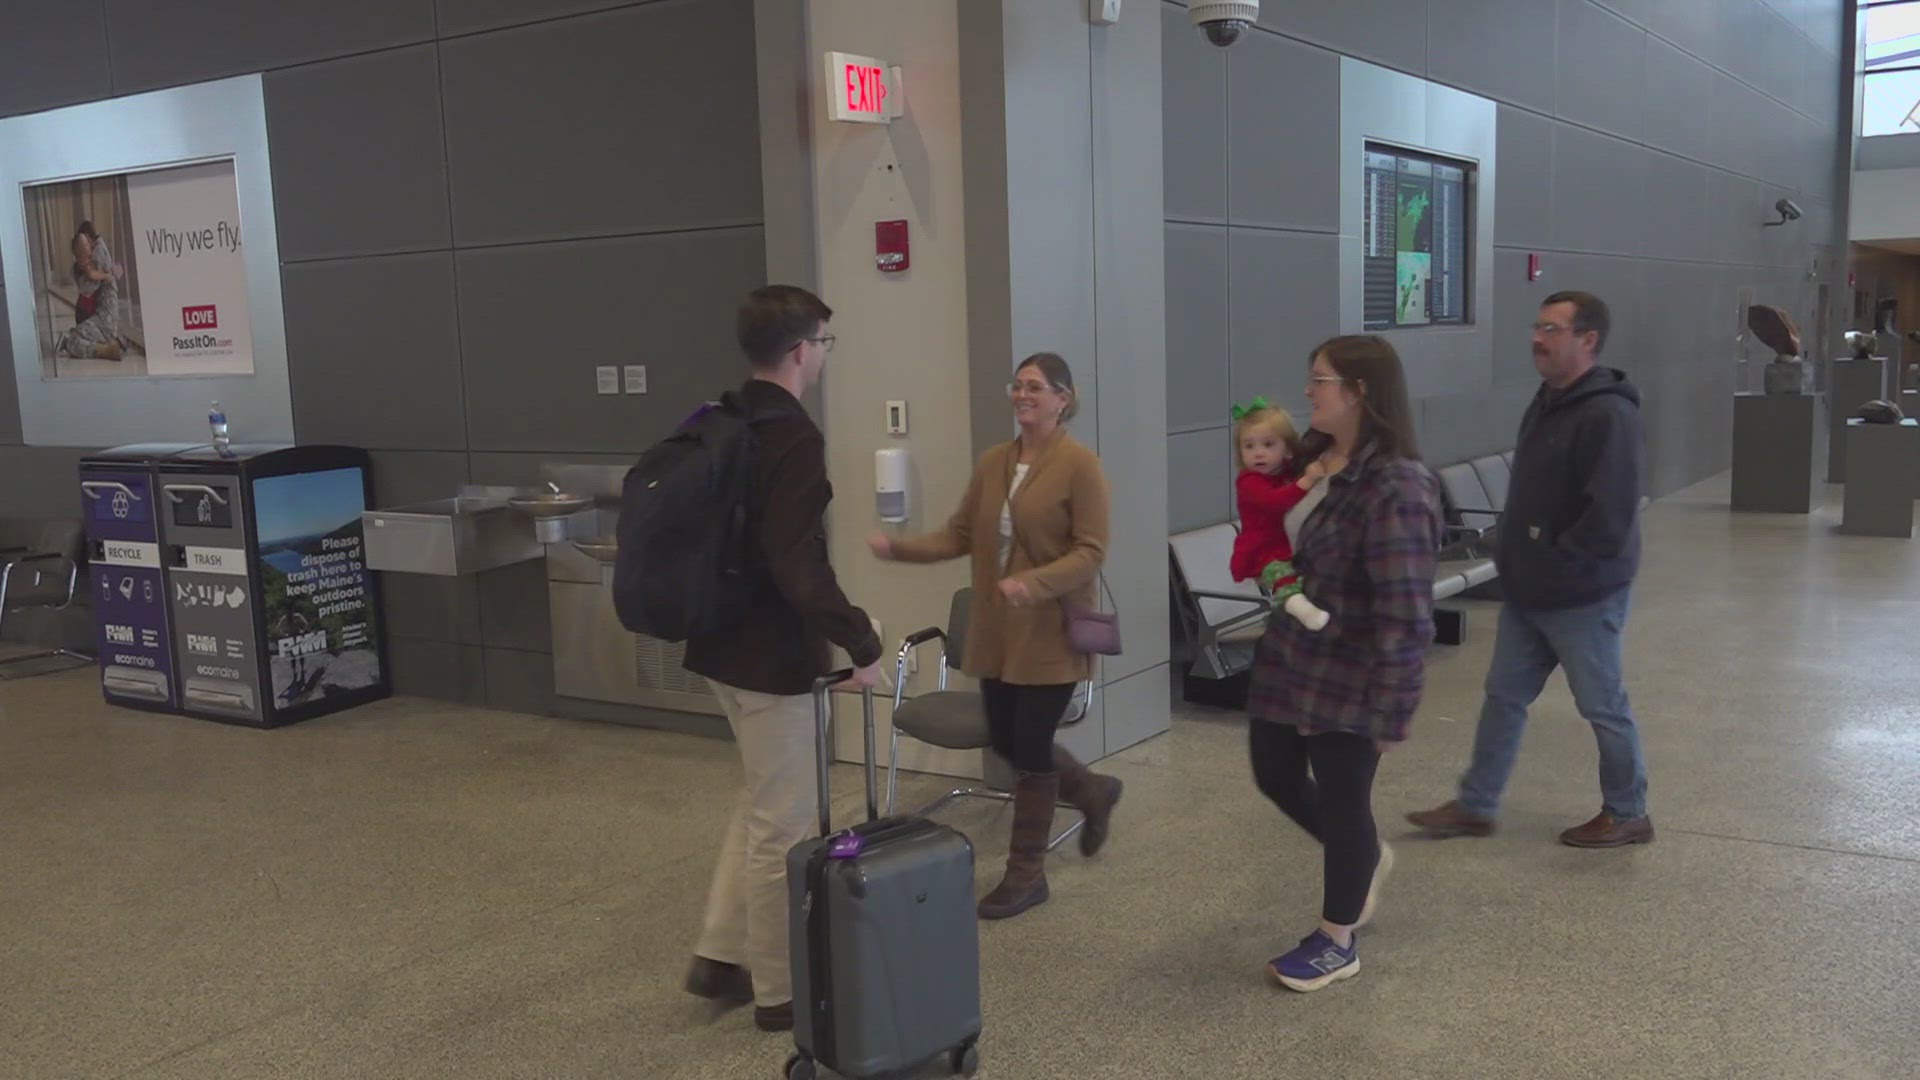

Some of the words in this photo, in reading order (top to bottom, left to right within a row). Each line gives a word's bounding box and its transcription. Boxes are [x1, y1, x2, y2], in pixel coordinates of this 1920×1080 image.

[845, 63, 883, 114] EXIT
[146, 227, 183, 259] Why
[187, 228, 214, 250] we
[217, 220, 241, 253] fly.
[185, 310, 215, 325] LOVE
[322, 536, 359, 550] Please
[108, 547, 142, 560] RECYCLE
[193, 553, 222, 566] TRASH
[301, 551, 346, 567] dispose
[348, 546, 360, 558] of
[287, 568, 319, 583] trash
[320, 563, 348, 577] here
[349, 560, 362, 572] to
[286, 582, 317, 597] keep
[319, 573, 363, 590] Maine's
[312, 586, 364, 604] outdoors
[318, 600, 366, 619] pristine.
